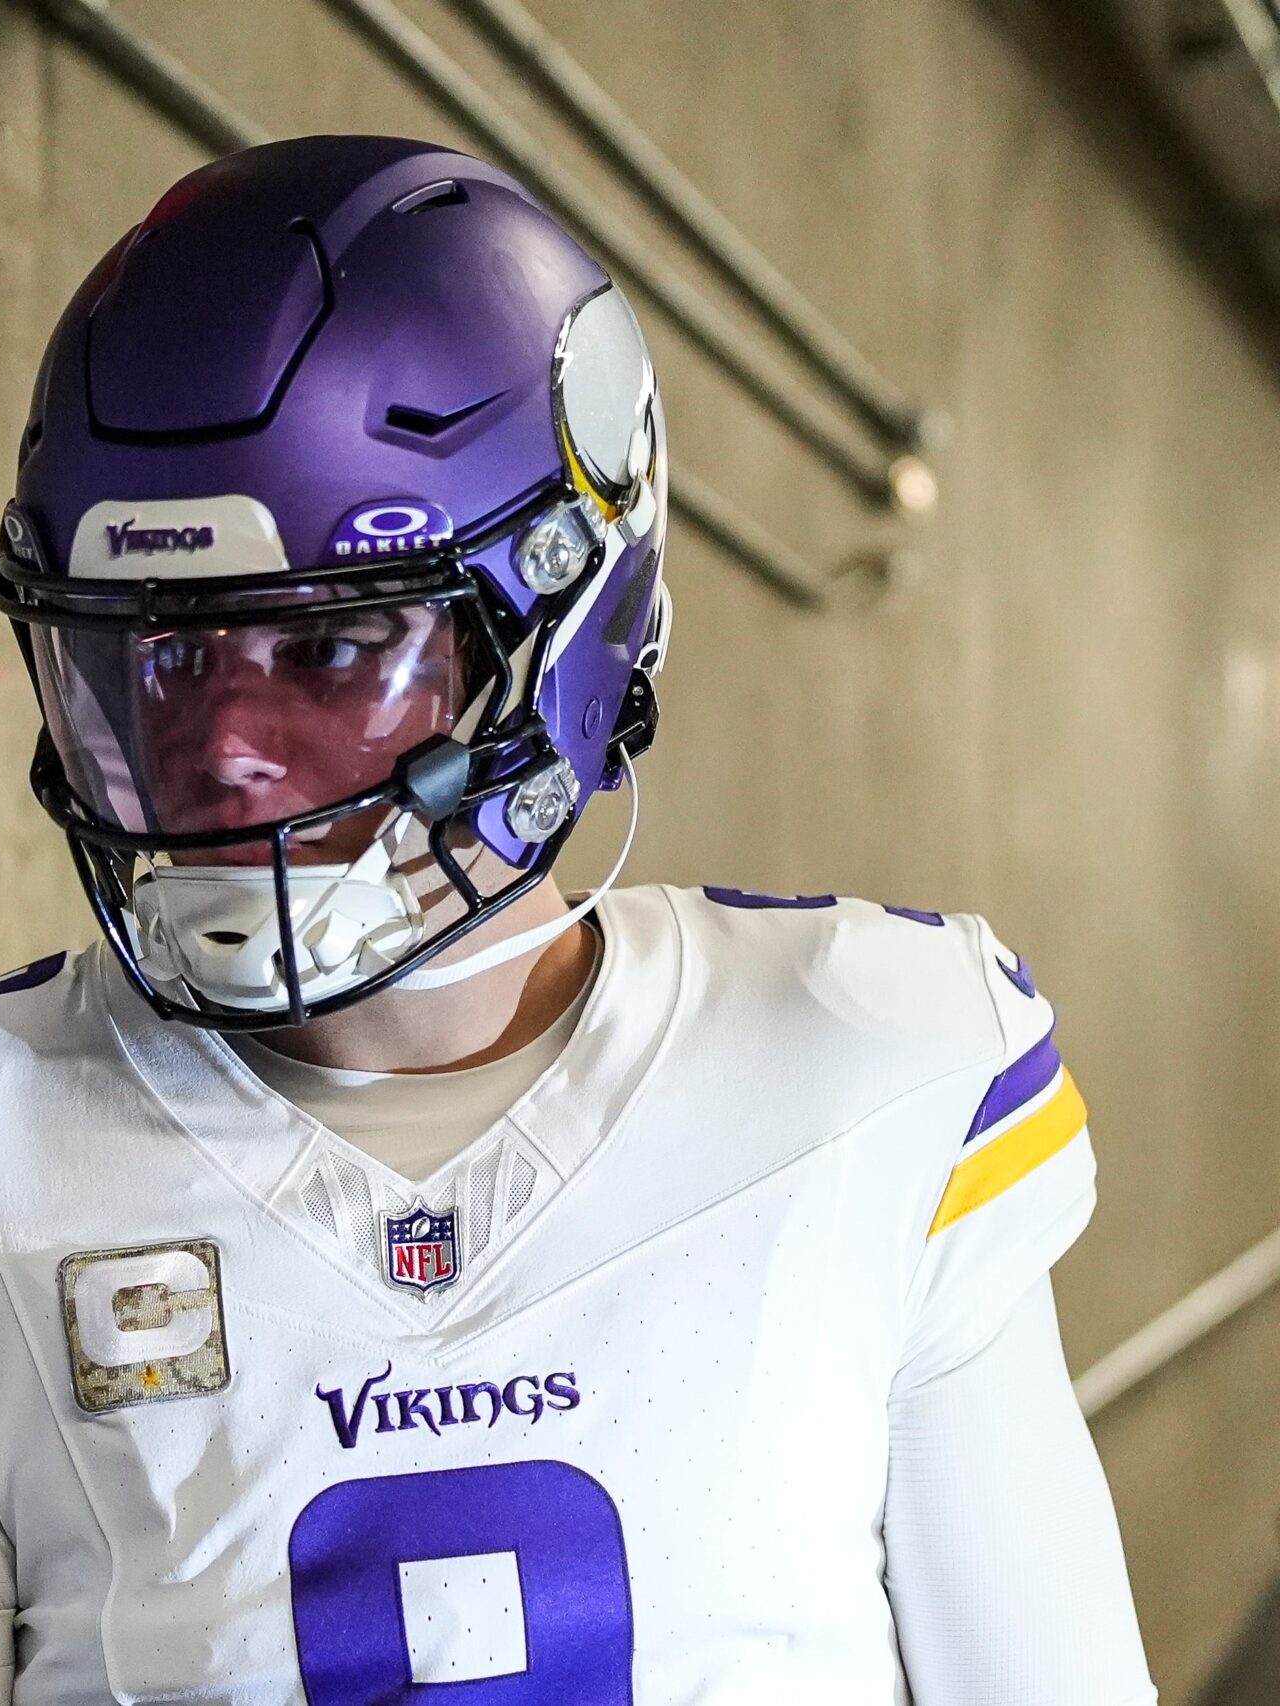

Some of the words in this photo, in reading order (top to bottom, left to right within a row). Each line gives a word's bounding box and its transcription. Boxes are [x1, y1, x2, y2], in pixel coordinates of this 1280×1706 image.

[335, 532, 443, 555] OAKLEY
[395, 1244, 451, 1282] NFL
[75, 1251, 212, 1367] C
